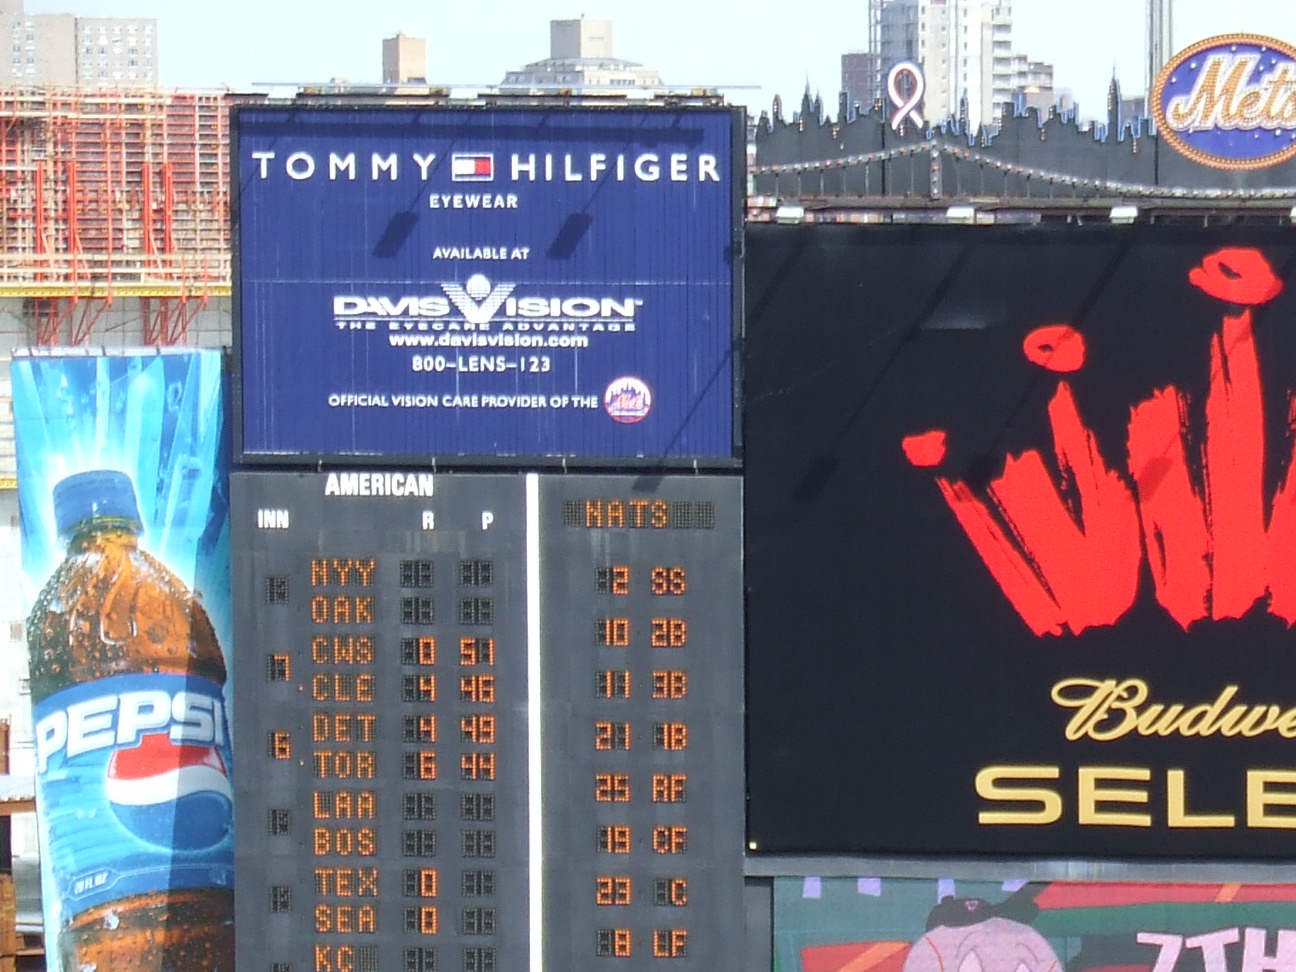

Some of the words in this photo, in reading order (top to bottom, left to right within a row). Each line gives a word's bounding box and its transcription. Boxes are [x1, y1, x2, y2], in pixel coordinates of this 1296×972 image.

[252, 152, 435, 180] TOMMY
[512, 154, 719, 181] HILFIGER
[430, 195, 517, 208] EYEWEAR
[433, 247, 506, 259] AVAILABLE
[511, 248, 529, 259] AT
[333, 296, 450, 316] DAVIS
[389, 332, 588, 347] www.davisvision.com
[413, 356, 550, 372] 800-LENS-123
[329, 394, 389, 406] OFFICIAL
[392, 395, 438, 407] VISION
[442, 395, 478, 407] CARE
[482, 395, 546, 407] PROVIDER
[550, 396, 569, 408] OF
[571, 396, 598, 408] THE
[325, 473, 433, 496] AMERICAN
[258, 510, 289, 528] INN
[423, 511, 434, 529] R
[482, 512, 493, 529] P
[586, 500, 668, 527] NATS
[312, 560, 375, 585] NYY
[613, 566, 630, 594] 2
[652, 567, 686, 594] SS
[312, 595, 372, 623] OAK
[605, 618, 630, 646] 10
[652, 618, 687, 647] 2B
[312, 637, 372, 664] CWS
[419, 636, 436, 665] 0
[460, 637, 495, 666] 51
[313, 673, 372, 701] CLE
[419, 675, 437, 701] 4
[461, 674, 495, 702] 46
[606, 671, 631, 697] 11
[653, 670, 687, 698] 3B
[36, 690, 224, 774] PEPSI
[314, 714, 375, 741] DET
[420, 715, 437, 741] 4
[461, 715, 496, 743] 49
[596, 722, 630, 749] 21
[663, 722, 688, 750] 1B
[314, 750, 374, 778] TOR
[419, 751, 437, 779] 6
[461, 754, 496, 779] 44
[596, 773, 631, 802] 25
[652, 774, 687, 801] RF
[314, 791, 375, 819] LAA
[314, 827, 375, 856] BOS
[607, 826, 631, 853] 19
[653, 826, 687, 853] CF
[316, 868, 378, 896] TEX
[420, 869, 438, 897] 0
[596, 877, 632, 904] 23
[671, 878, 688, 905] C
[315, 904, 375, 932] SEA
[421, 906, 438, 934] 0
[614, 928, 632, 956] 8
[654, 929, 688, 957] LF
[315, 945, 353, 972] KC
